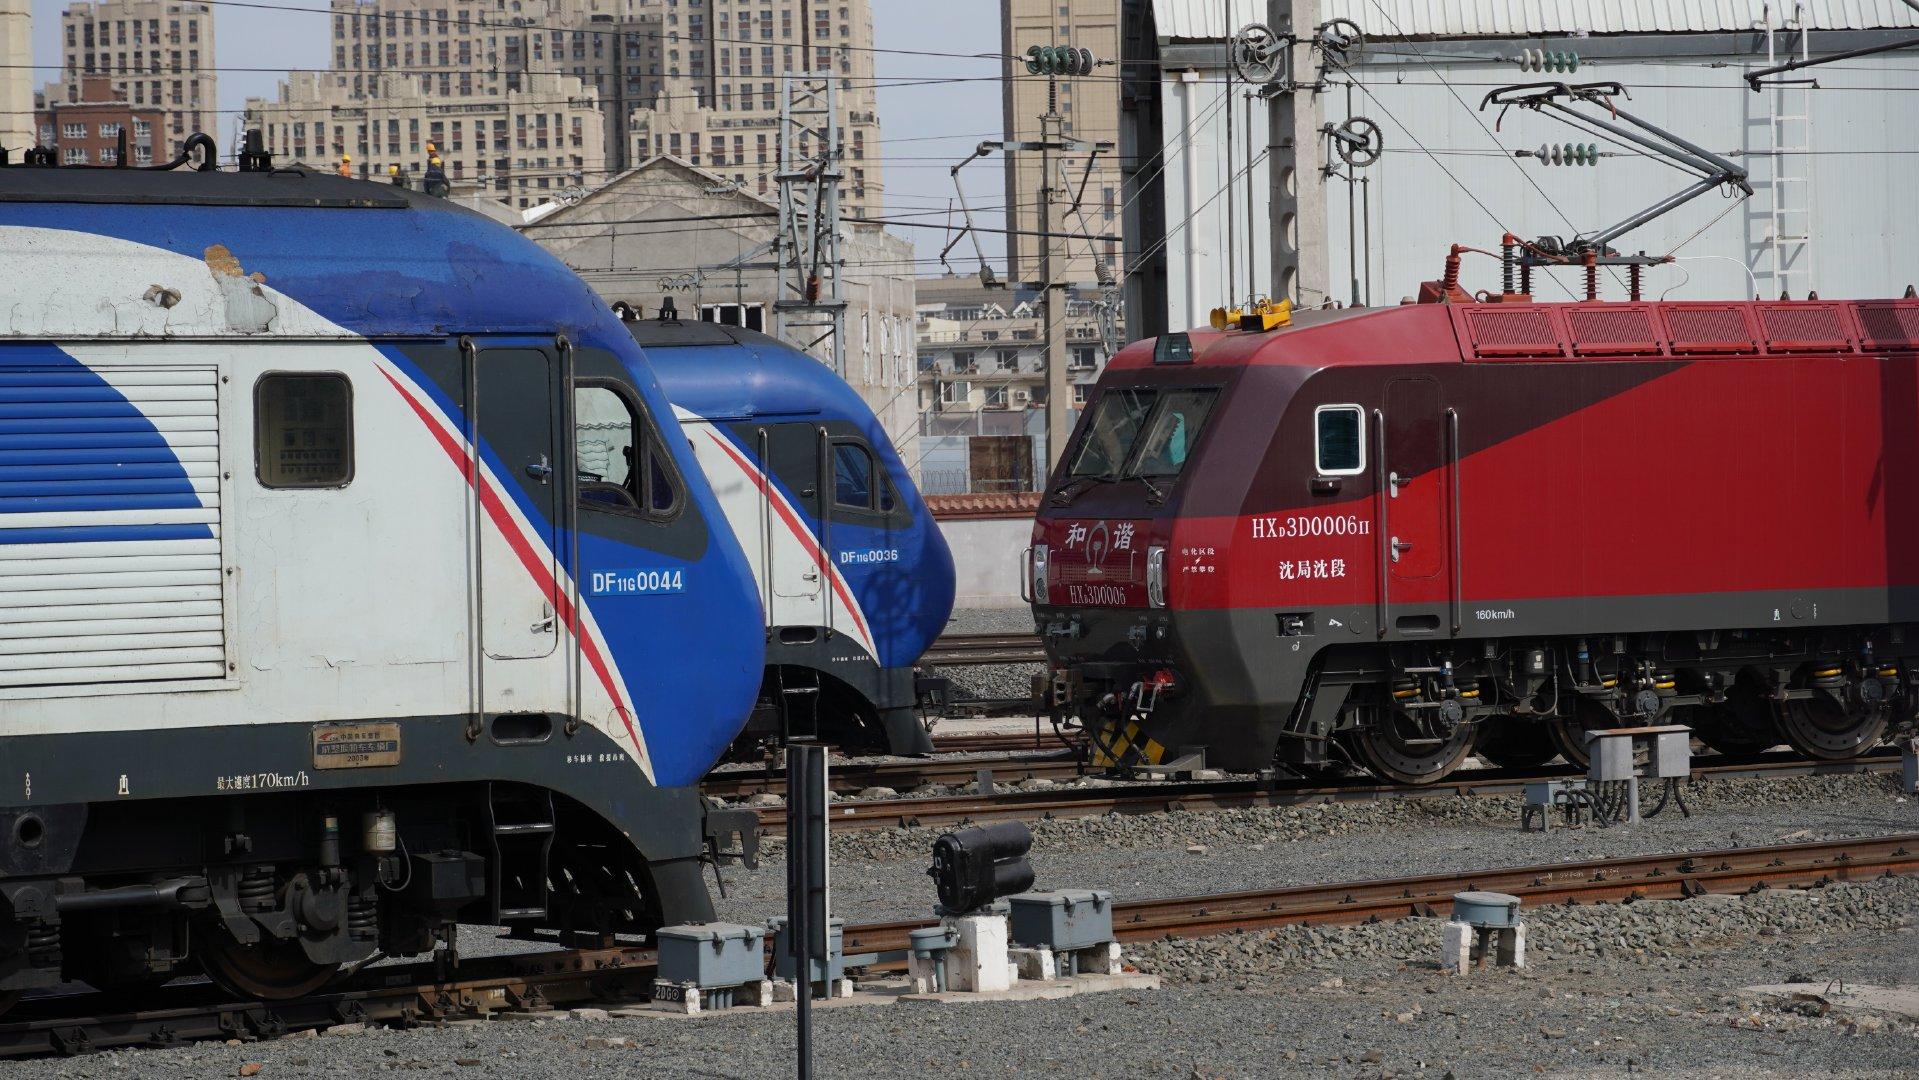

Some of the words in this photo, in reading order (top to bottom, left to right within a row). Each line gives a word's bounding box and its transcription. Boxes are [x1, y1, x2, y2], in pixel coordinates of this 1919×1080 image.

[1065, 522, 1087, 549] 和
[1113, 522, 1135, 549] 谐
[841, 550, 898, 563] DF11G0036
[1279, 559, 1346, 579] 沈局沈段
[592, 570, 683, 592] DF11G0044
[1069, 585, 1126, 605] HXD3D0006
[1475, 609, 1515, 619] 160km/h
